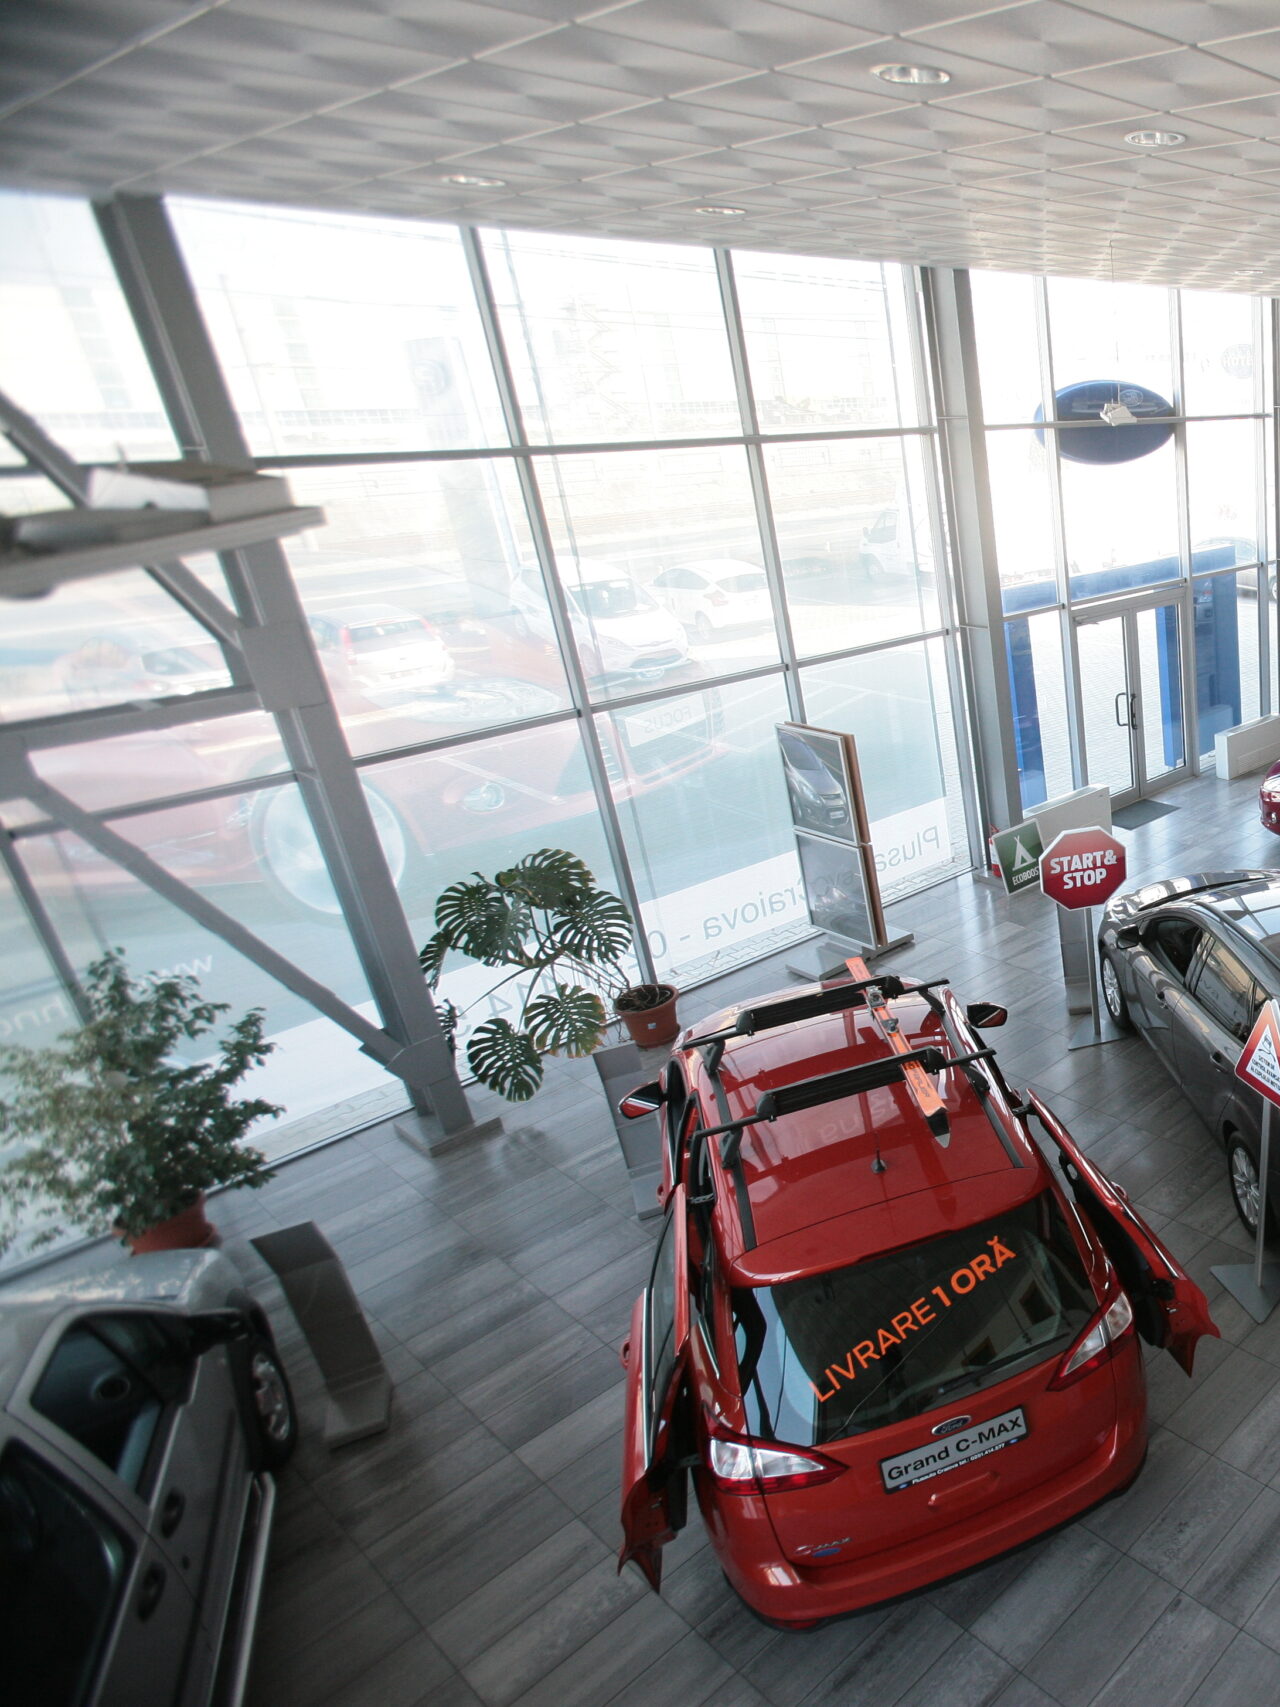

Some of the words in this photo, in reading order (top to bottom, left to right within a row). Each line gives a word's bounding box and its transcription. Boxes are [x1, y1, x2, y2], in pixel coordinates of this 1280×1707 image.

[1050, 849, 1117, 875] START&
[1063, 868, 1107, 889] STOP
[809, 1297, 937, 1402] LIVRARE
[931, 1286, 951, 1307] 1
[950, 1236, 1016, 1294] ORĂ
[888, 1446, 950, 1480] Grand
[955, 1416, 1022, 1453] C-MAX
